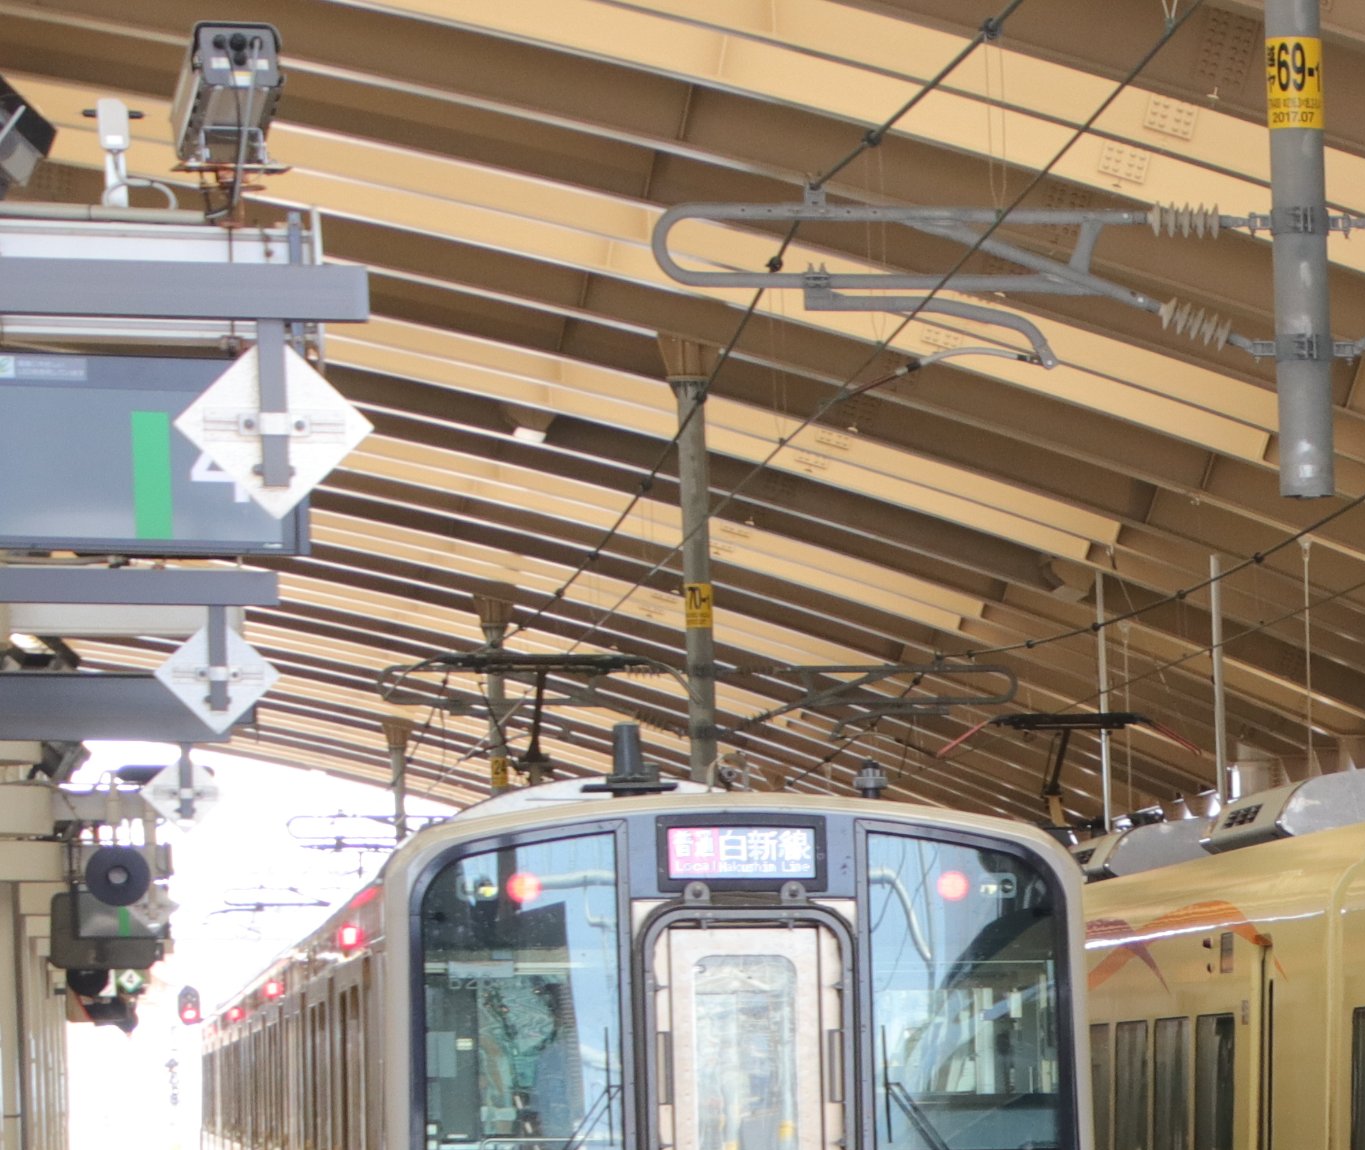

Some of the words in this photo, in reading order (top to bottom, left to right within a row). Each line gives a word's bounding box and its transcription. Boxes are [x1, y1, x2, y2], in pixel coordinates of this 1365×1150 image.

[1272, 111, 1315, 124] 2017.07
[672, 829, 715, 858] 普通
[718, 829, 812, 861] 白新線
[674, 860, 718, 872] Local
[719, 860, 777, 873] Hakushin
[781, 860, 811, 873] Line
